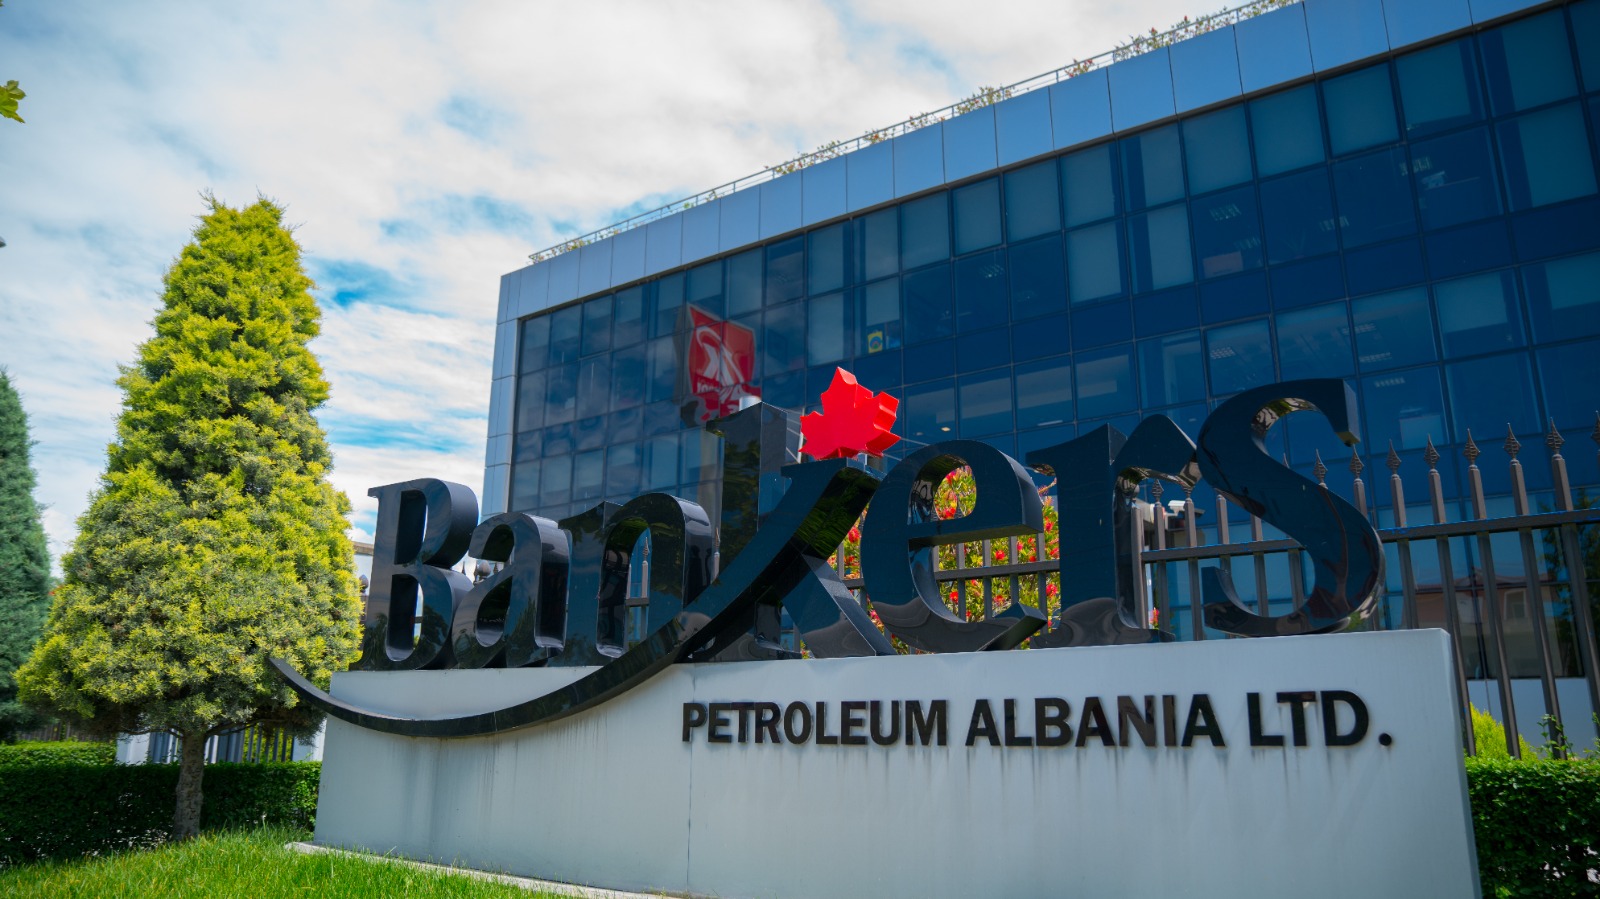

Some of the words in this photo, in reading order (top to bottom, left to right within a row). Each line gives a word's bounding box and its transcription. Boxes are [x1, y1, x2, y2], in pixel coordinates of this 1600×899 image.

[270, 378, 1384, 736] Bankers
[682, 700, 948, 747] PETROLEUM
[965, 695, 1226, 748] ALBANIA
[1247, 690, 1393, 748] LTD.
